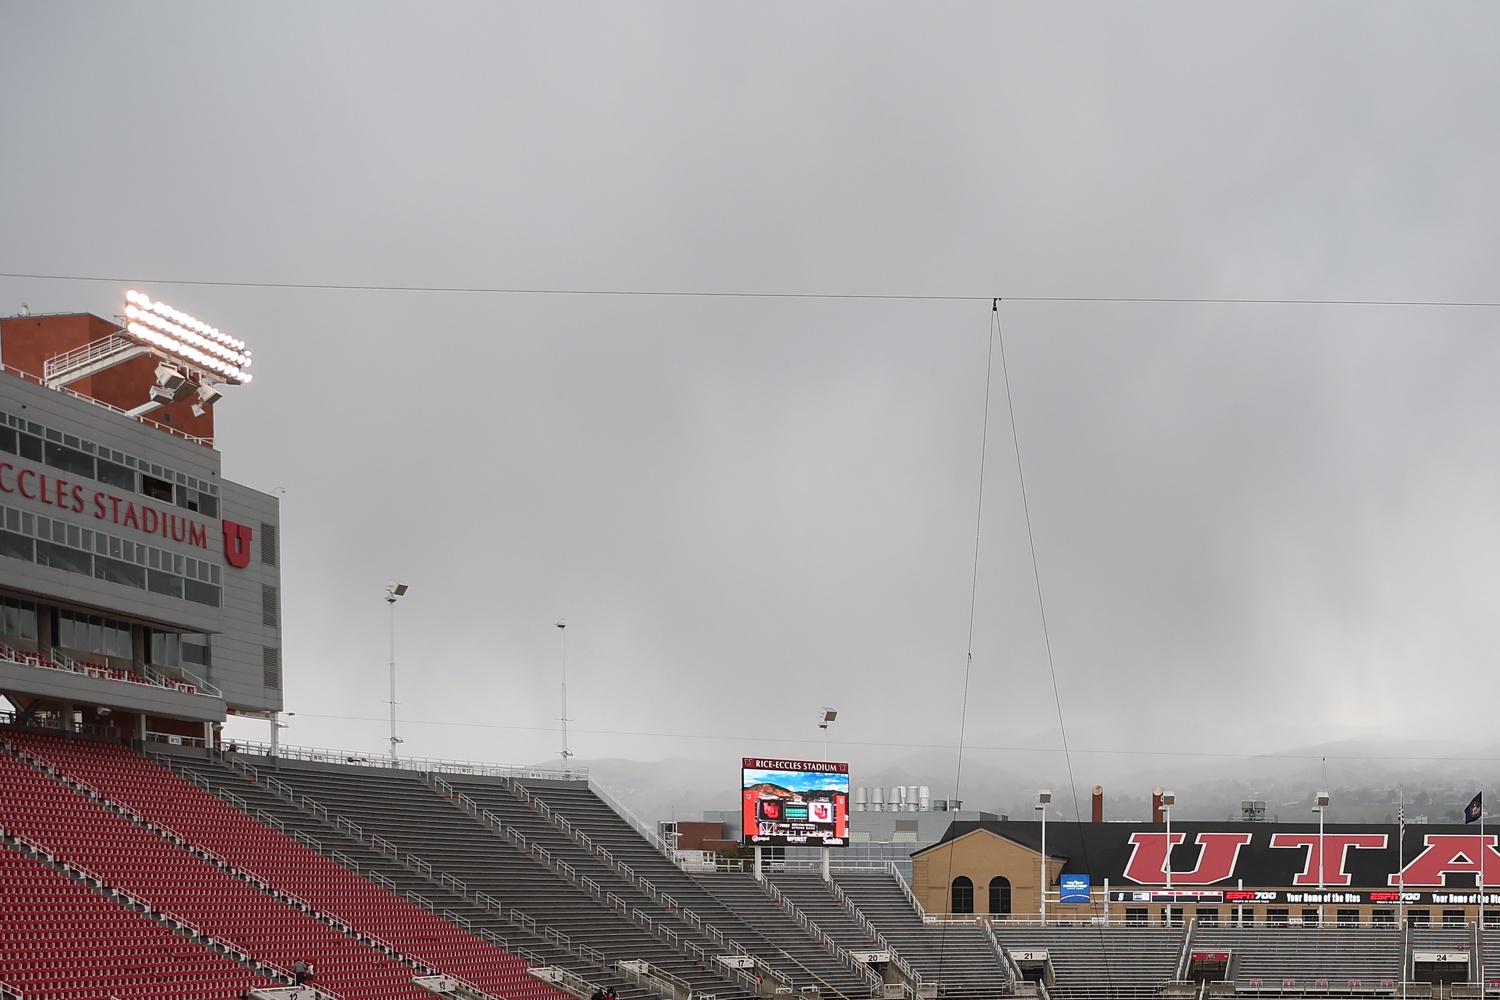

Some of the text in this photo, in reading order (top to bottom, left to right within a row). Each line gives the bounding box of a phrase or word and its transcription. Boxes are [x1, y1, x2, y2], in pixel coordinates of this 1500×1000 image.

[94, 491, 207, 549] STADIUM
[222, 520, 253, 569] U
[756, 760, 837, 771] RICE-ECCLES STADIUM
[1286, 893, 1360, 903] Your Home of the Utes
[1432, 893, 1448, 904] Your
[1449, 893, 1468, 904] Home
[1469, 893, 1477, 904] of
[738, 959, 745, 967] 17
[868, 954, 878, 962] 20
[439, 981, 446, 990] 13
